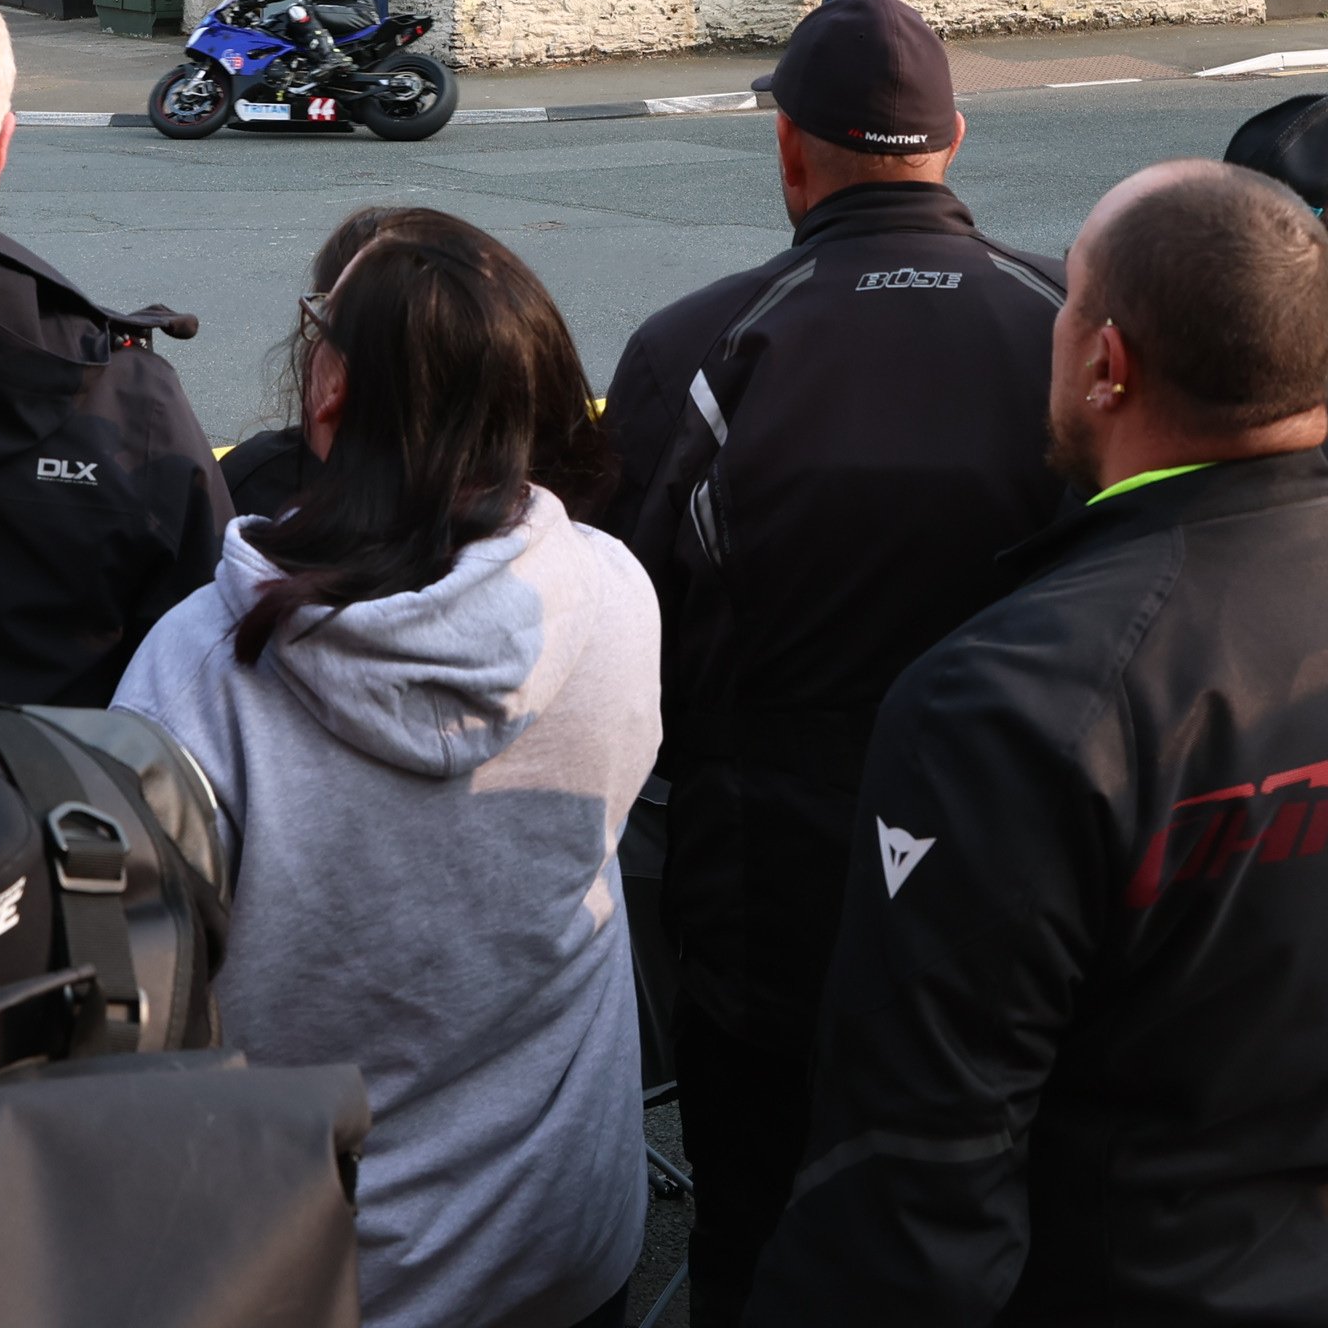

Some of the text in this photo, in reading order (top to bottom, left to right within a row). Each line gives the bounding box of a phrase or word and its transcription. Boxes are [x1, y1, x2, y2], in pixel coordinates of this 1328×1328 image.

[307, 98, 335, 120] 44
[865, 132, 928, 144] MANTHEY
[37, 457, 98, 481] DLX
